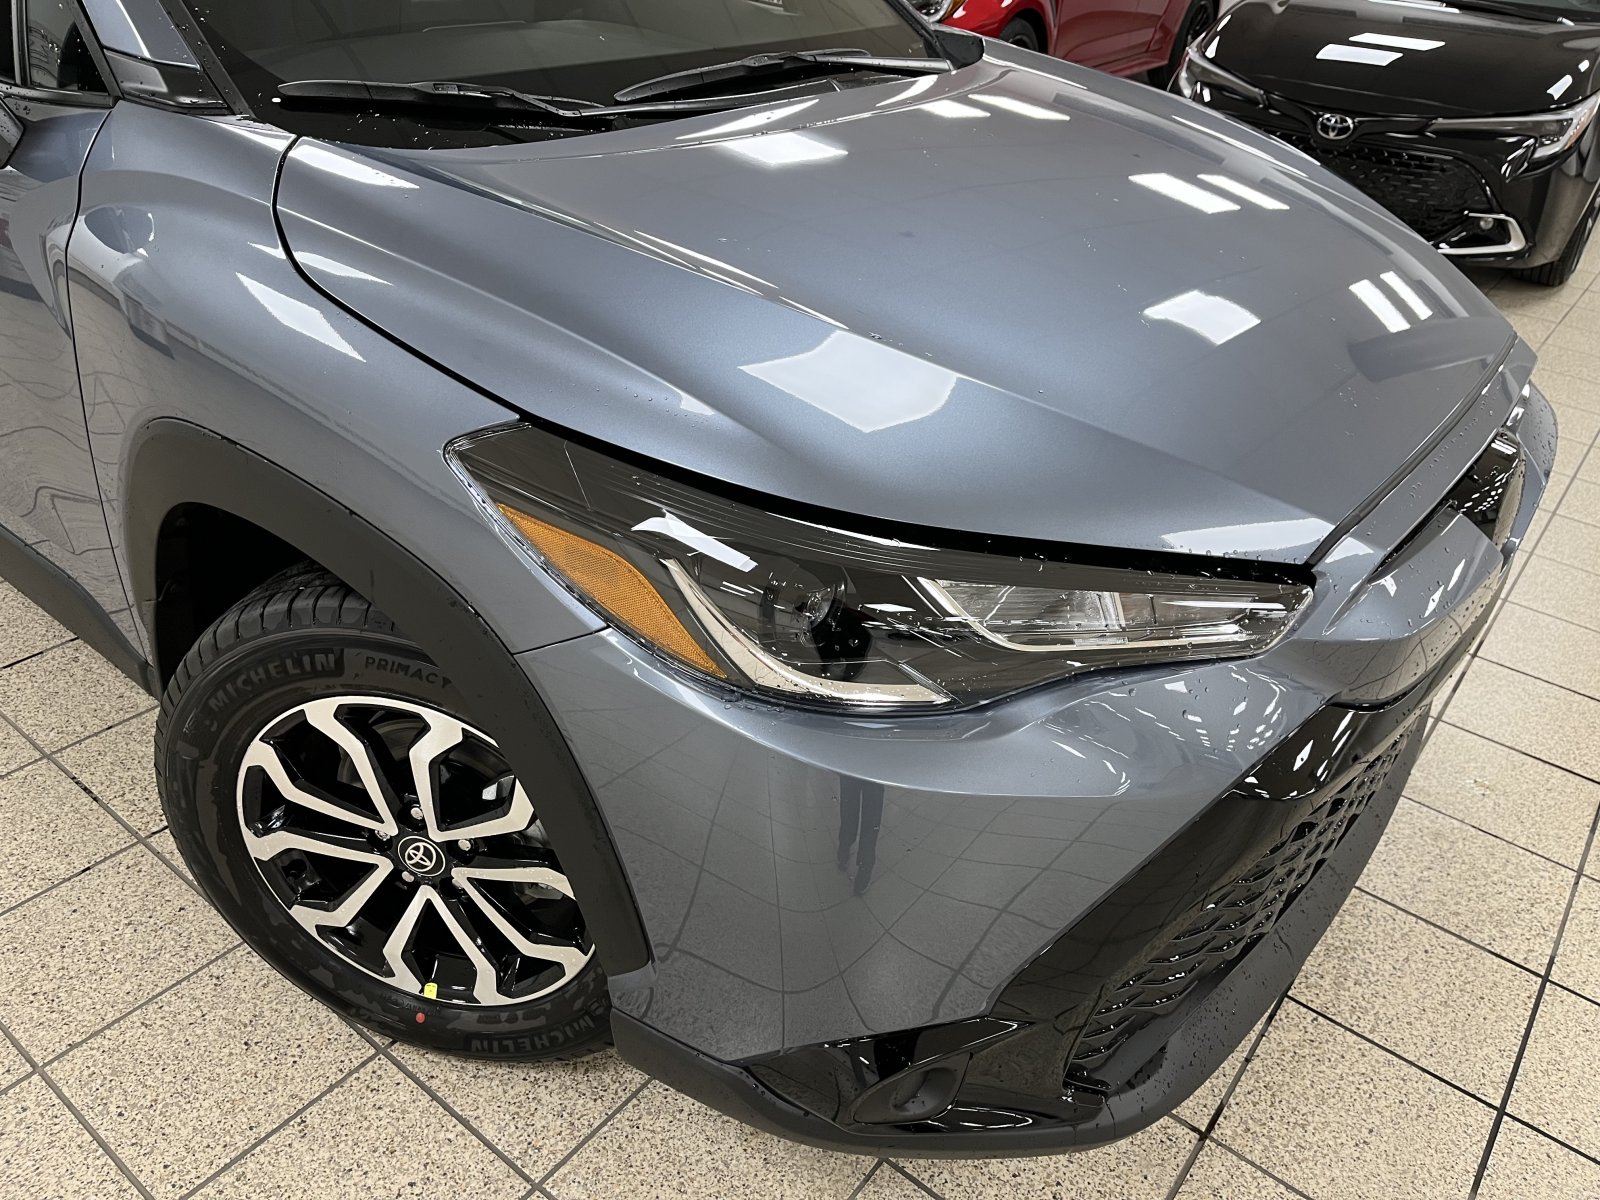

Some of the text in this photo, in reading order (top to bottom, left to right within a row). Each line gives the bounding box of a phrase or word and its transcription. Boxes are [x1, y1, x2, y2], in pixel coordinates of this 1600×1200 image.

[208, 653, 335, 712] MICHELIN
[364, 655, 453, 689] PRIMACY
[470, 1013, 596, 1054] MICHELIN
